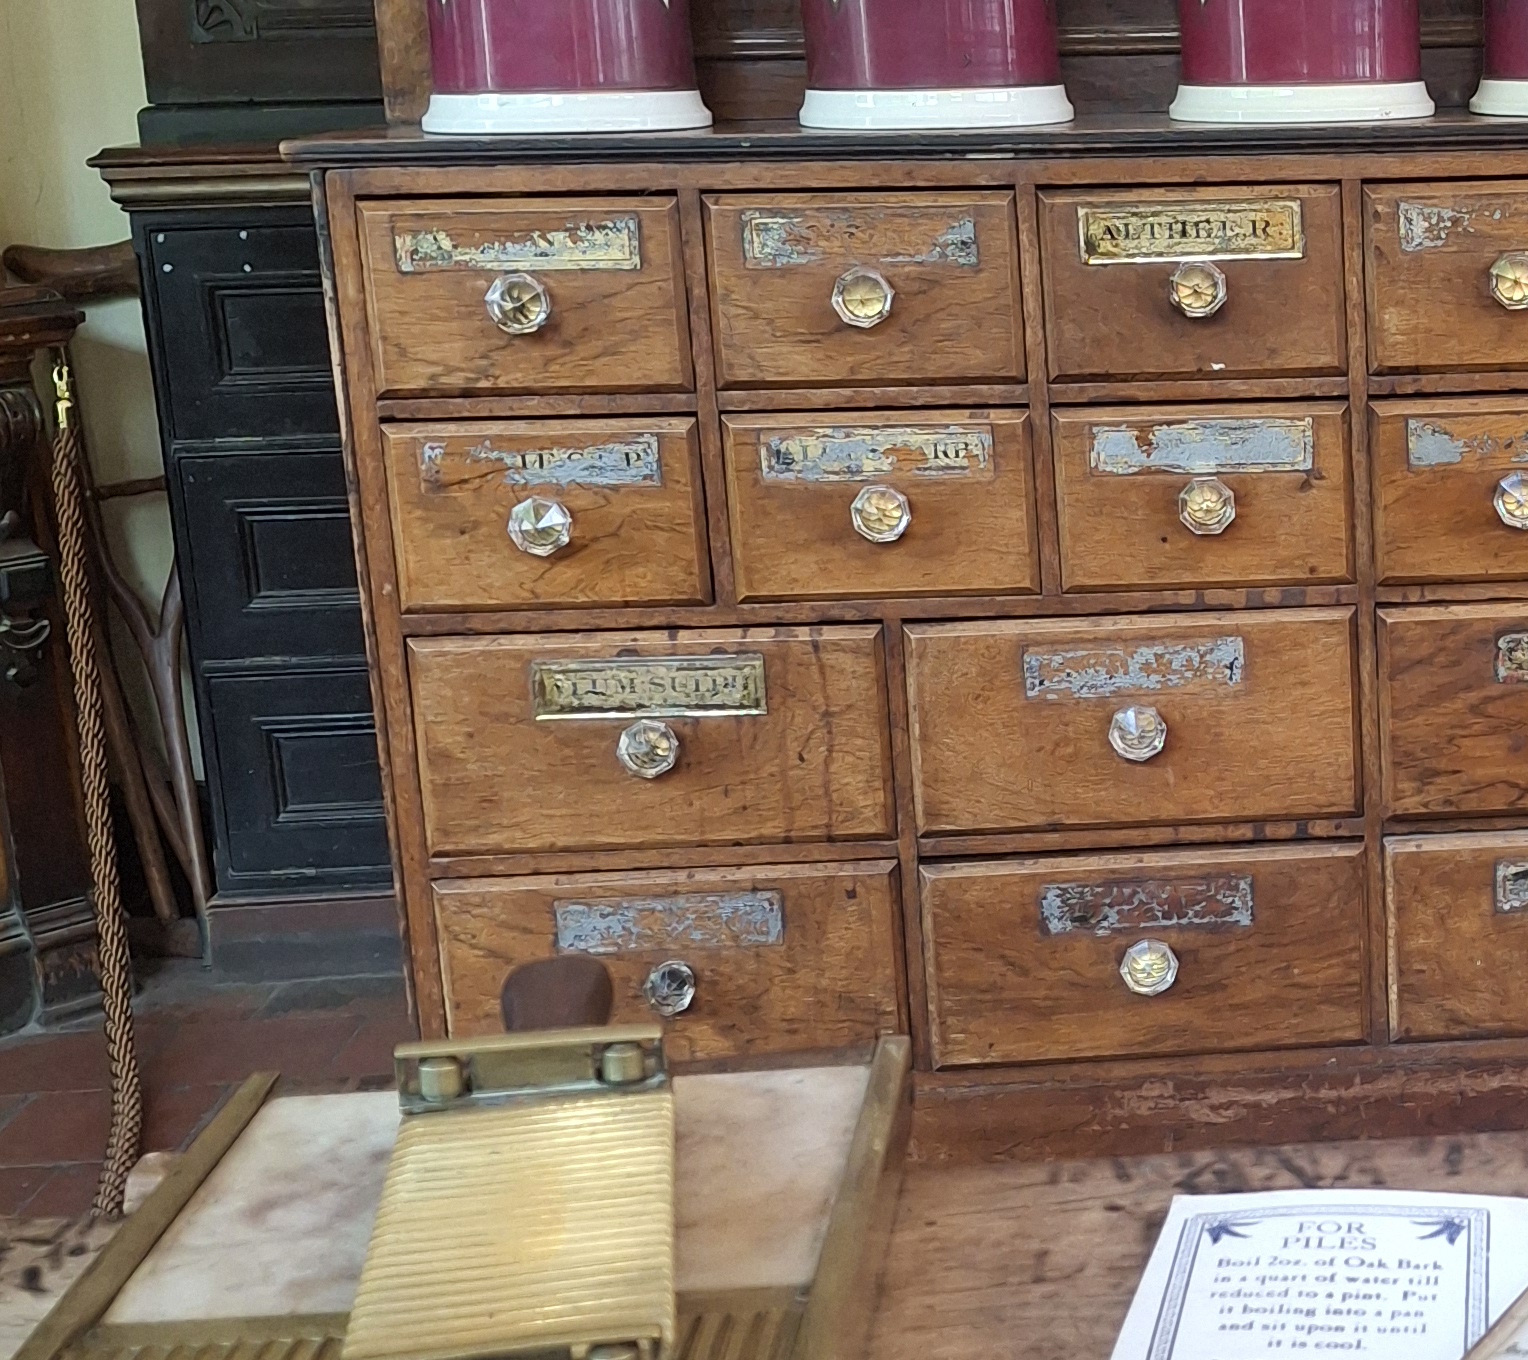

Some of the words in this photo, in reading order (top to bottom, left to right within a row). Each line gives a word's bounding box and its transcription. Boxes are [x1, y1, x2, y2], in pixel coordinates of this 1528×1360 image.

[1297, 1220, 1366, 1235] FOR
[1281, 1236, 1378, 1251] PILES
[1217, 1256, 1261, 1268] Boil
[1313, 1256, 1338, 1268] of
[1343, 1256, 1389, 1269] Oak
[1397, 1258, 1444, 1271] Bark
[1213, 1274, 1232, 1284] in
[1238, 1275, 1248, 1283] a
[1255, 1274, 1307, 1286] quart
[1314, 1272, 1338, 1283] of
[1345, 1275, 1400, 1286] water
[1408, 1275, 1440, 1287] till
[1209, 1287, 1291, 1299] reduced
[1297, 1289, 1319, 1299] to
[1325, 1290, 1335, 1299] a
[1401, 1290, 1439, 1302] Put
[1218, 1304, 1234, 1315] it
[1241, 1303, 1317, 1318] boiling
[1325, 1306, 1367, 1317] into
[1374, 1310, 1383, 1318] a
[1390, 1309, 1425, 1321] pan
[1217, 1320, 1255, 1331] and
[1260, 1321, 1287, 1332] sit
[1294, 1324, 1346, 1336] upon
[1353, 1323, 1369, 1334] it
[1376, 1322, 1428, 1335] until
[1267, 1339, 1283, 1349] it
[1290, 1340, 1308, 1349] is
[1314, 1338, 1367, 1350] cool.
